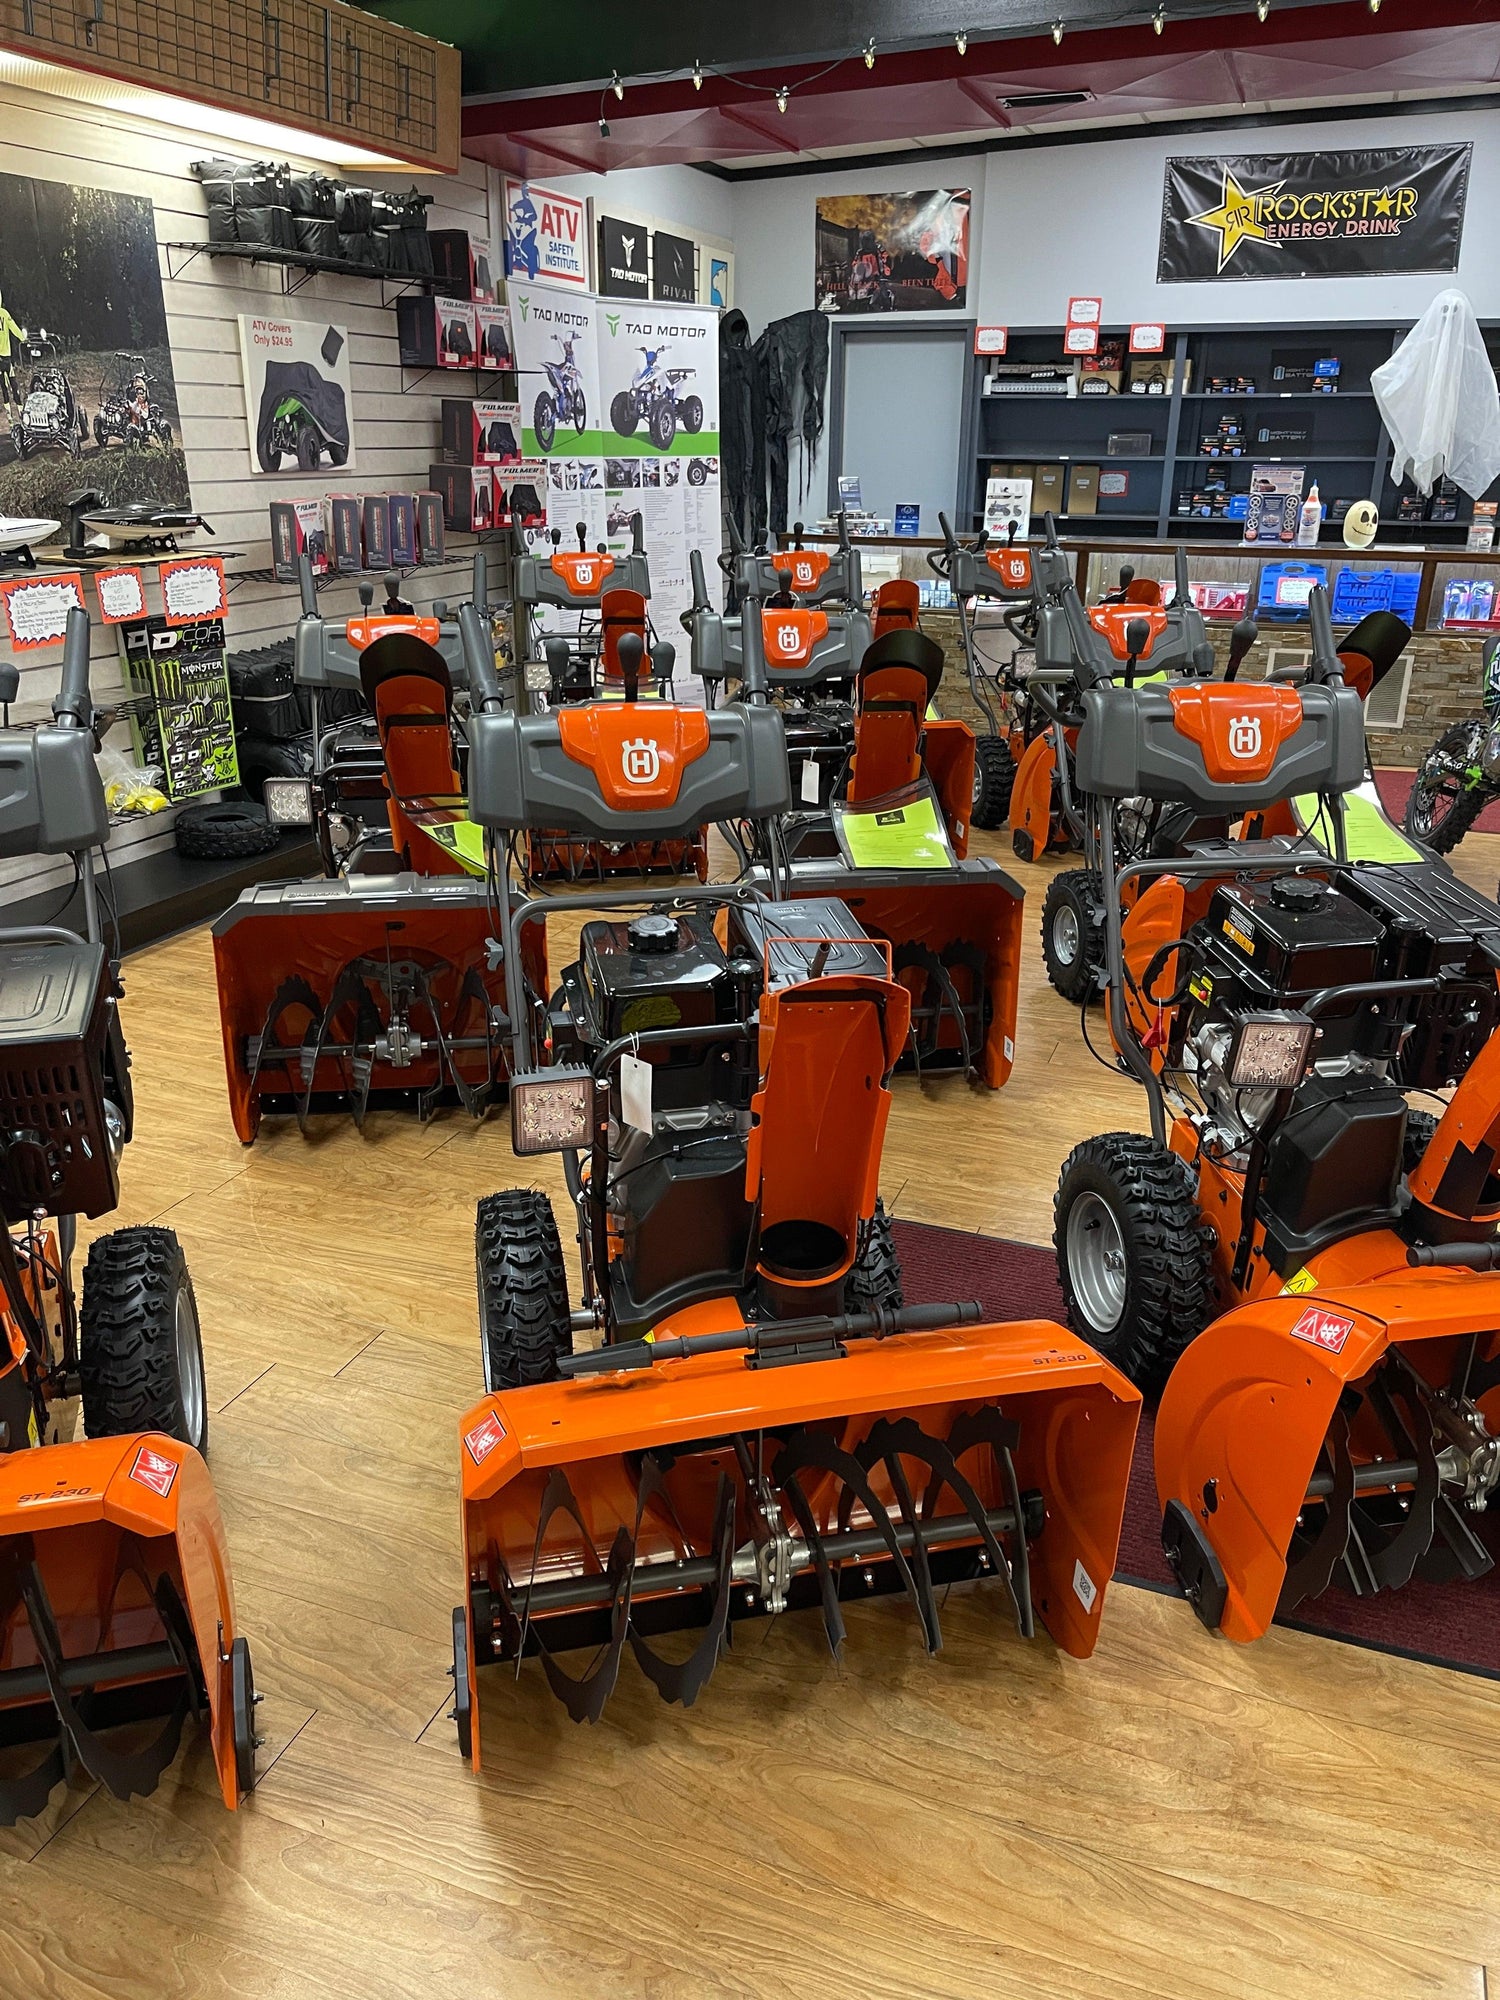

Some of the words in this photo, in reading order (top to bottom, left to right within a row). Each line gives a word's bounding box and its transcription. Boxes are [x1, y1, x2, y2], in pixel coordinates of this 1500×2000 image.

[1256, 188, 1416, 223] ROCKSTAR
[541, 203, 578, 242] ATV
[1266, 221, 1338, 239] ENERGY
[1345, 218, 1401, 237] DRINK
[548, 240, 575, 257] SAFETY
[610, 267, 624, 280] TAO
[624, 270, 648, 284] MOTOR
[662, 284, 694, 301] RIVAL
[442, 300, 469, 310] FULMER
[481, 306, 505, 314] FULMER
[533, 306, 552, 322] TAO
[554, 312, 589, 328] MOTOR
[252, 319, 267, 331] ATV
[268, 321, 292, 334] Covers
[625, 322, 653, 336] TAO
[657, 324, 706, 339] MOTOR
[253, 334, 270, 348] Only
[272, 335, 293, 347] $24.95
[181, 660, 223, 675] MONSTER
[1032, 1357, 1051, 1366] ST
[1057, 1353, 1088, 1363] 230
[17, 1492, 46, 1503] ST
[50, 1487, 92, 1499] 230
